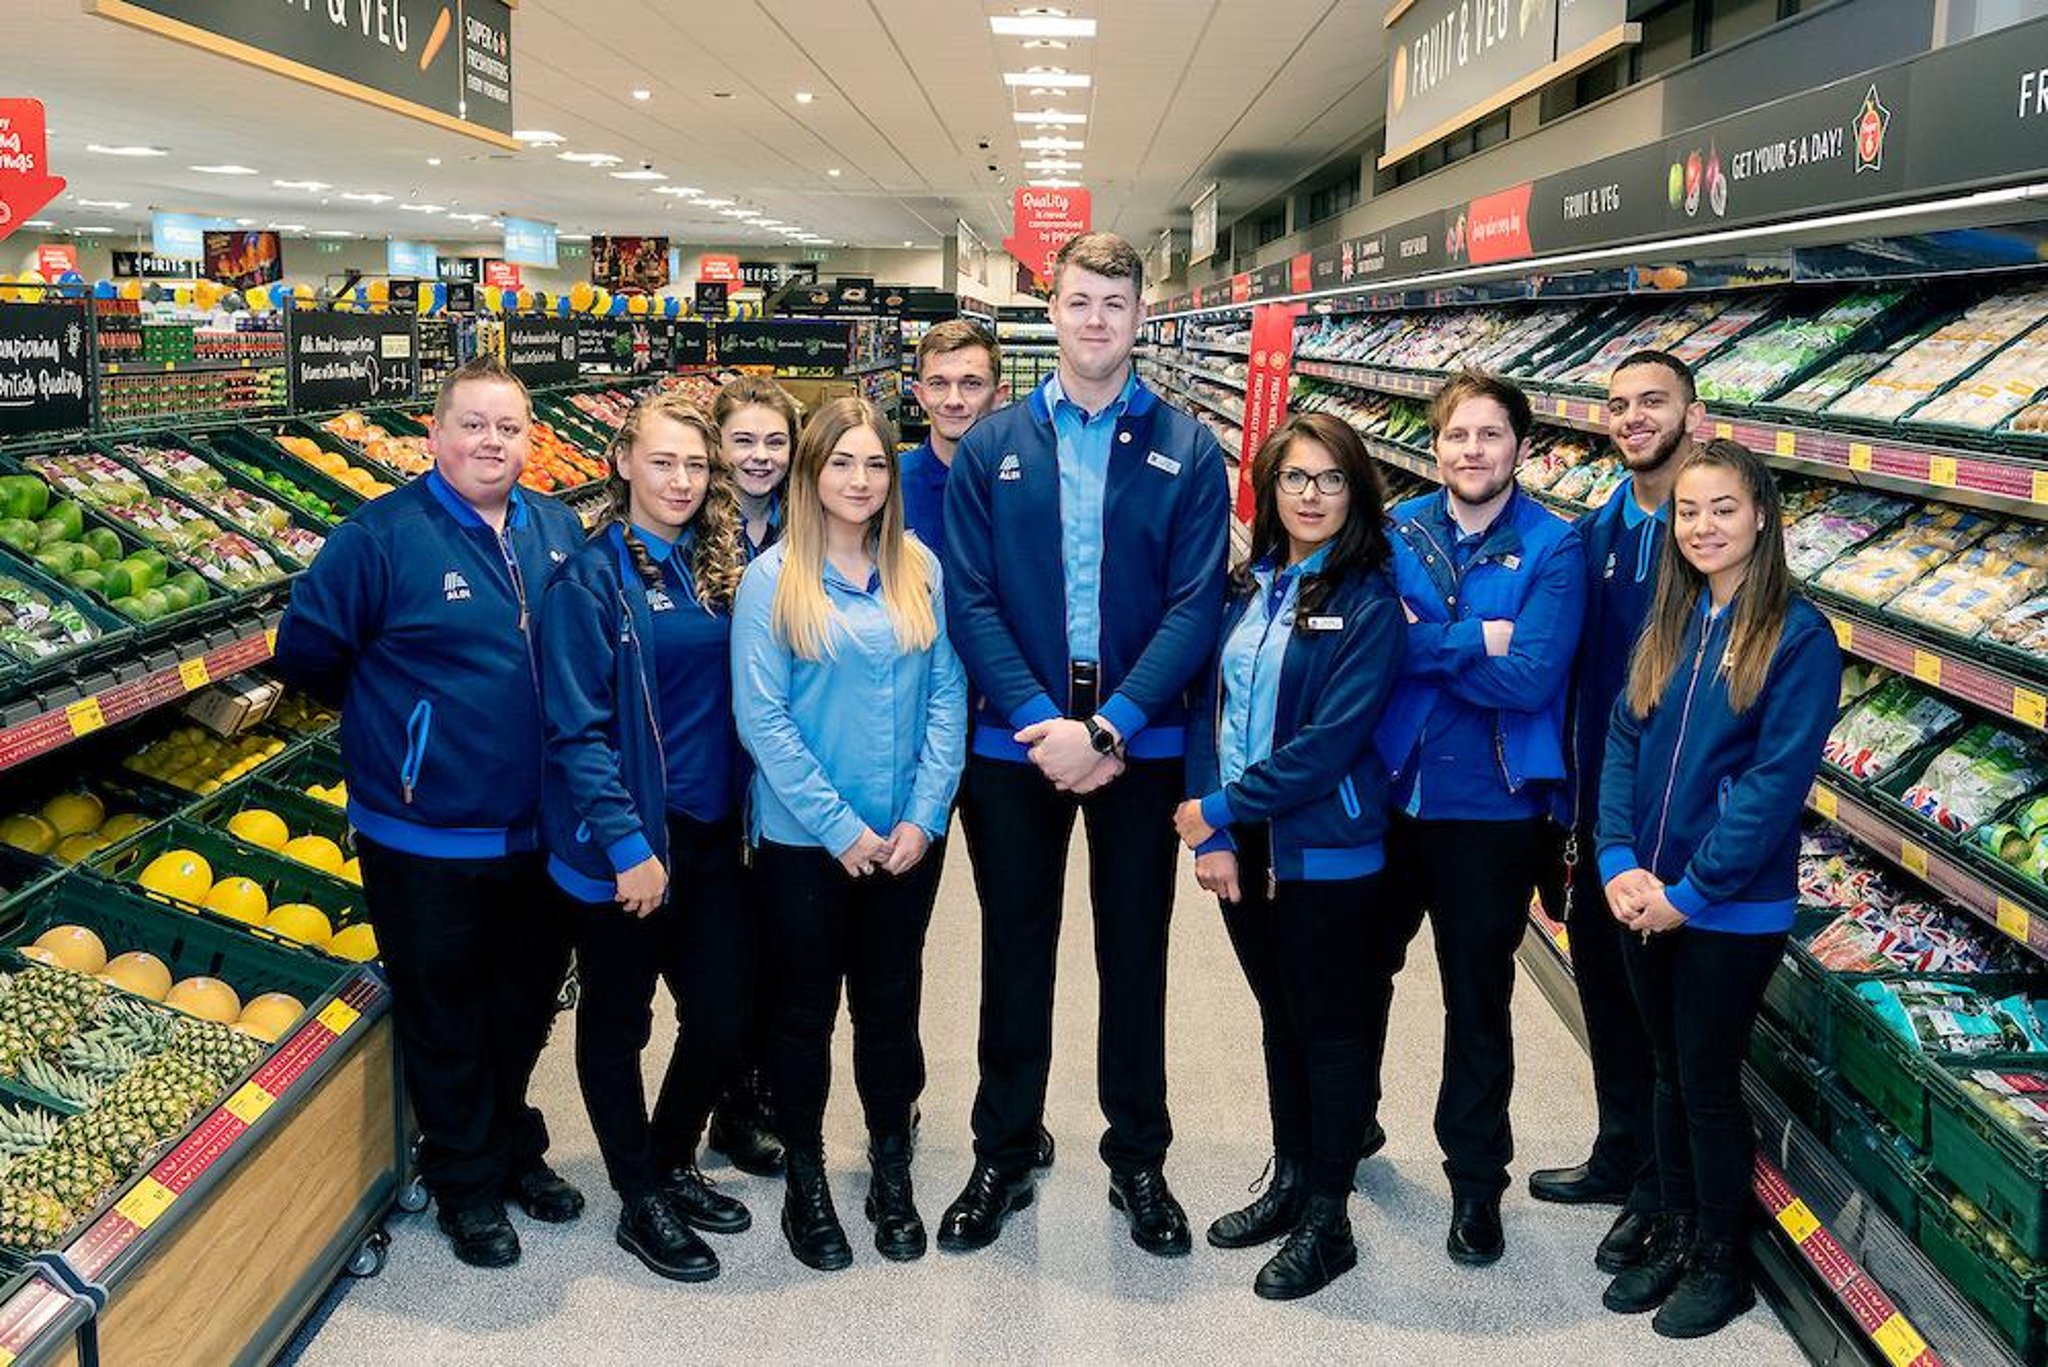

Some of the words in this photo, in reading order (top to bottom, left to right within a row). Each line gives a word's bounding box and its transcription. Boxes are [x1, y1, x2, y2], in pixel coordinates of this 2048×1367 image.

[360, 0, 407, 51] VEG
[1412, 11, 1455, 98] FRUIT
[1457, 0, 1469, 67] &
[1732, 150, 1753, 180] GET
[1754, 142, 1786, 175] YOUR
[1787, 138, 1797, 168] 5
[1798, 136, 1808, 165] A
[1811, 127, 1844, 163] DAY!
[1022, 191, 1069, 212] Quality
[1564, 192, 1589, 220] FRUIT
[1590, 189, 1600, 214] &
[1600, 184, 1621, 212] VEG
[1028, 220, 1084, 230] compromised
[135, 258, 186, 272] SPIRITS
[440, 263, 474, 277] WINE
[39, 367, 83, 401] Quality
